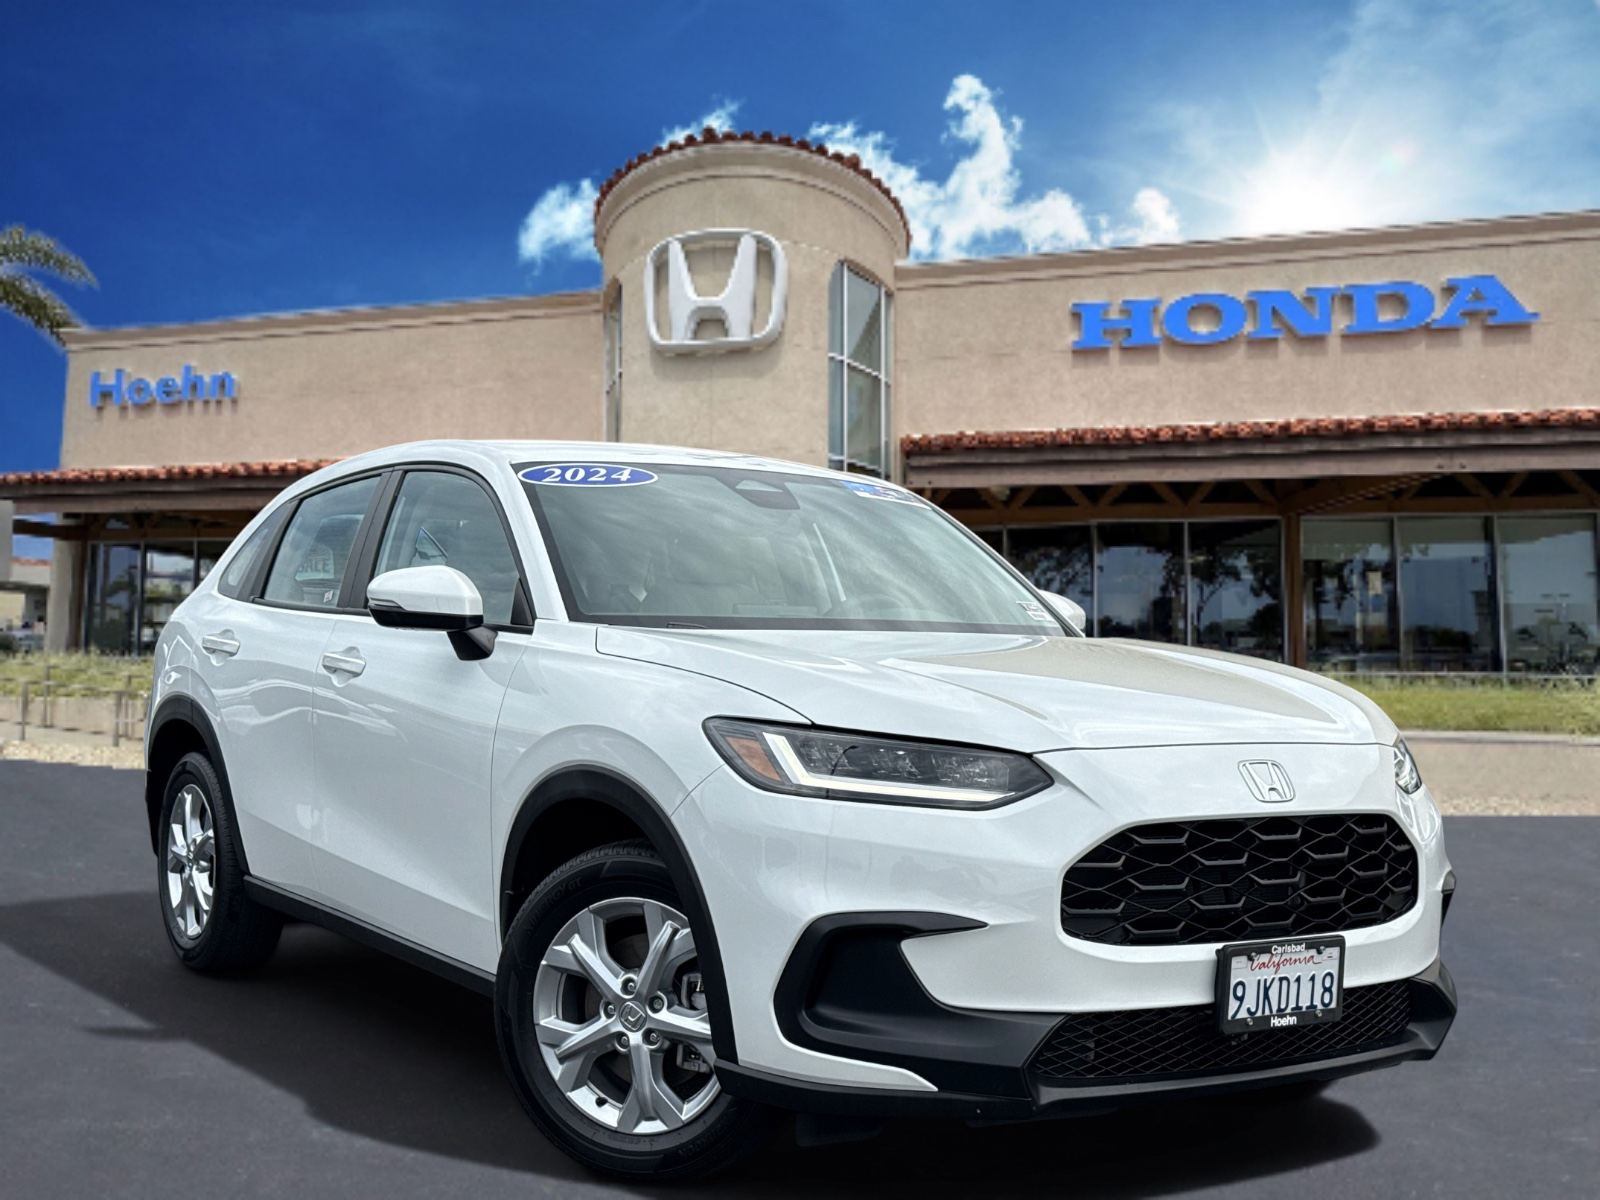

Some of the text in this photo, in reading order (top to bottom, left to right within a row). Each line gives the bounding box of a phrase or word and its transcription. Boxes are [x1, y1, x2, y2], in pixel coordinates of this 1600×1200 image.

[1070, 274, 1539, 351] HONDA
[90, 363, 236, 407] Hoehn
[543, 467, 634, 484] 2024
[1271, 943, 1306, 954] Carlsbad
[1250, 954, 1322, 975] California
[1230, 971, 1335, 1020] 9JKD118
[1270, 1015, 1298, 1027] Hoehn
